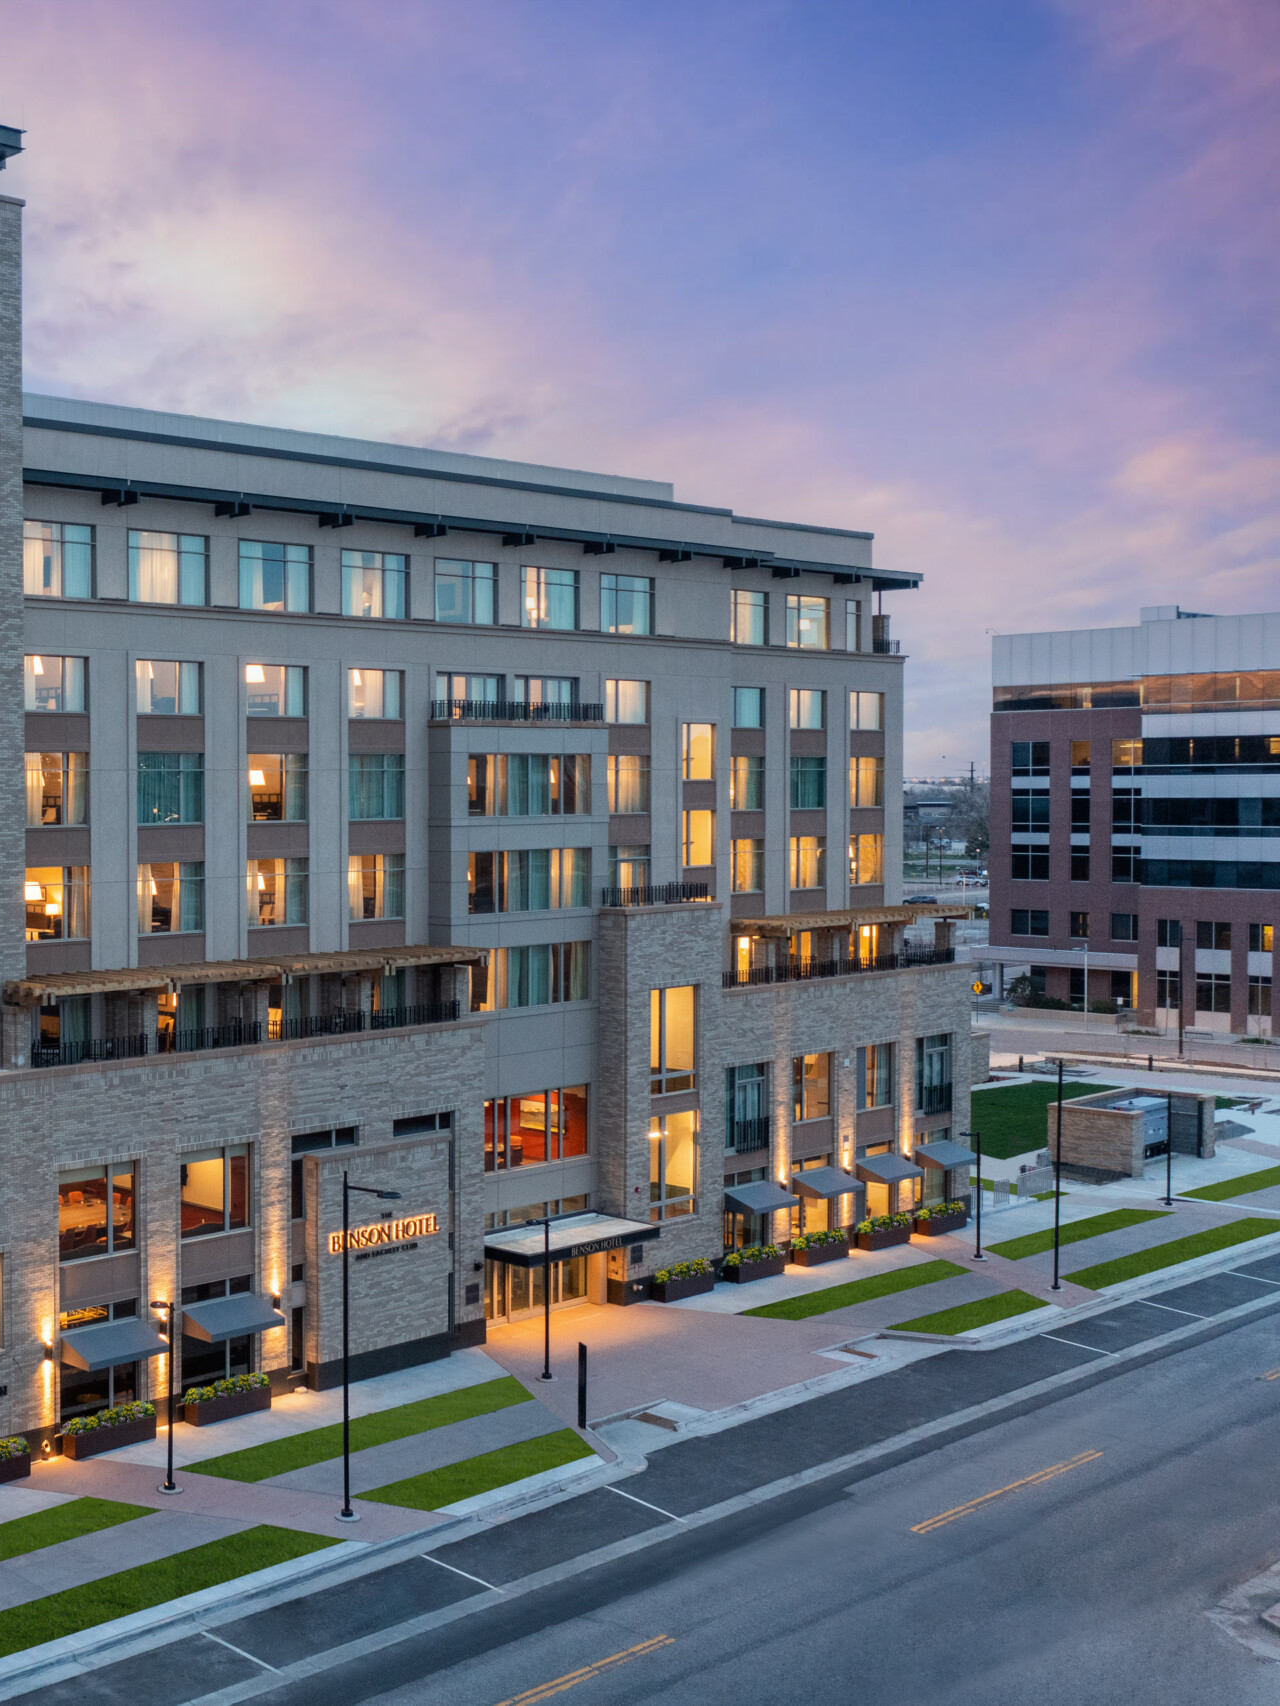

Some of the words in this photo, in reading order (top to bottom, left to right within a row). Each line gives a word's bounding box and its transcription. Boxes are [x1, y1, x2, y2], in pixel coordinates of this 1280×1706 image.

[381, 1211, 393, 1219] THE
[331, 1223, 391, 1253] BNSON
[393, 1214, 440, 1240] HOTEL
[571, 1242, 600, 1257] BENSON
[601, 1237, 623, 1249] HOTEL
